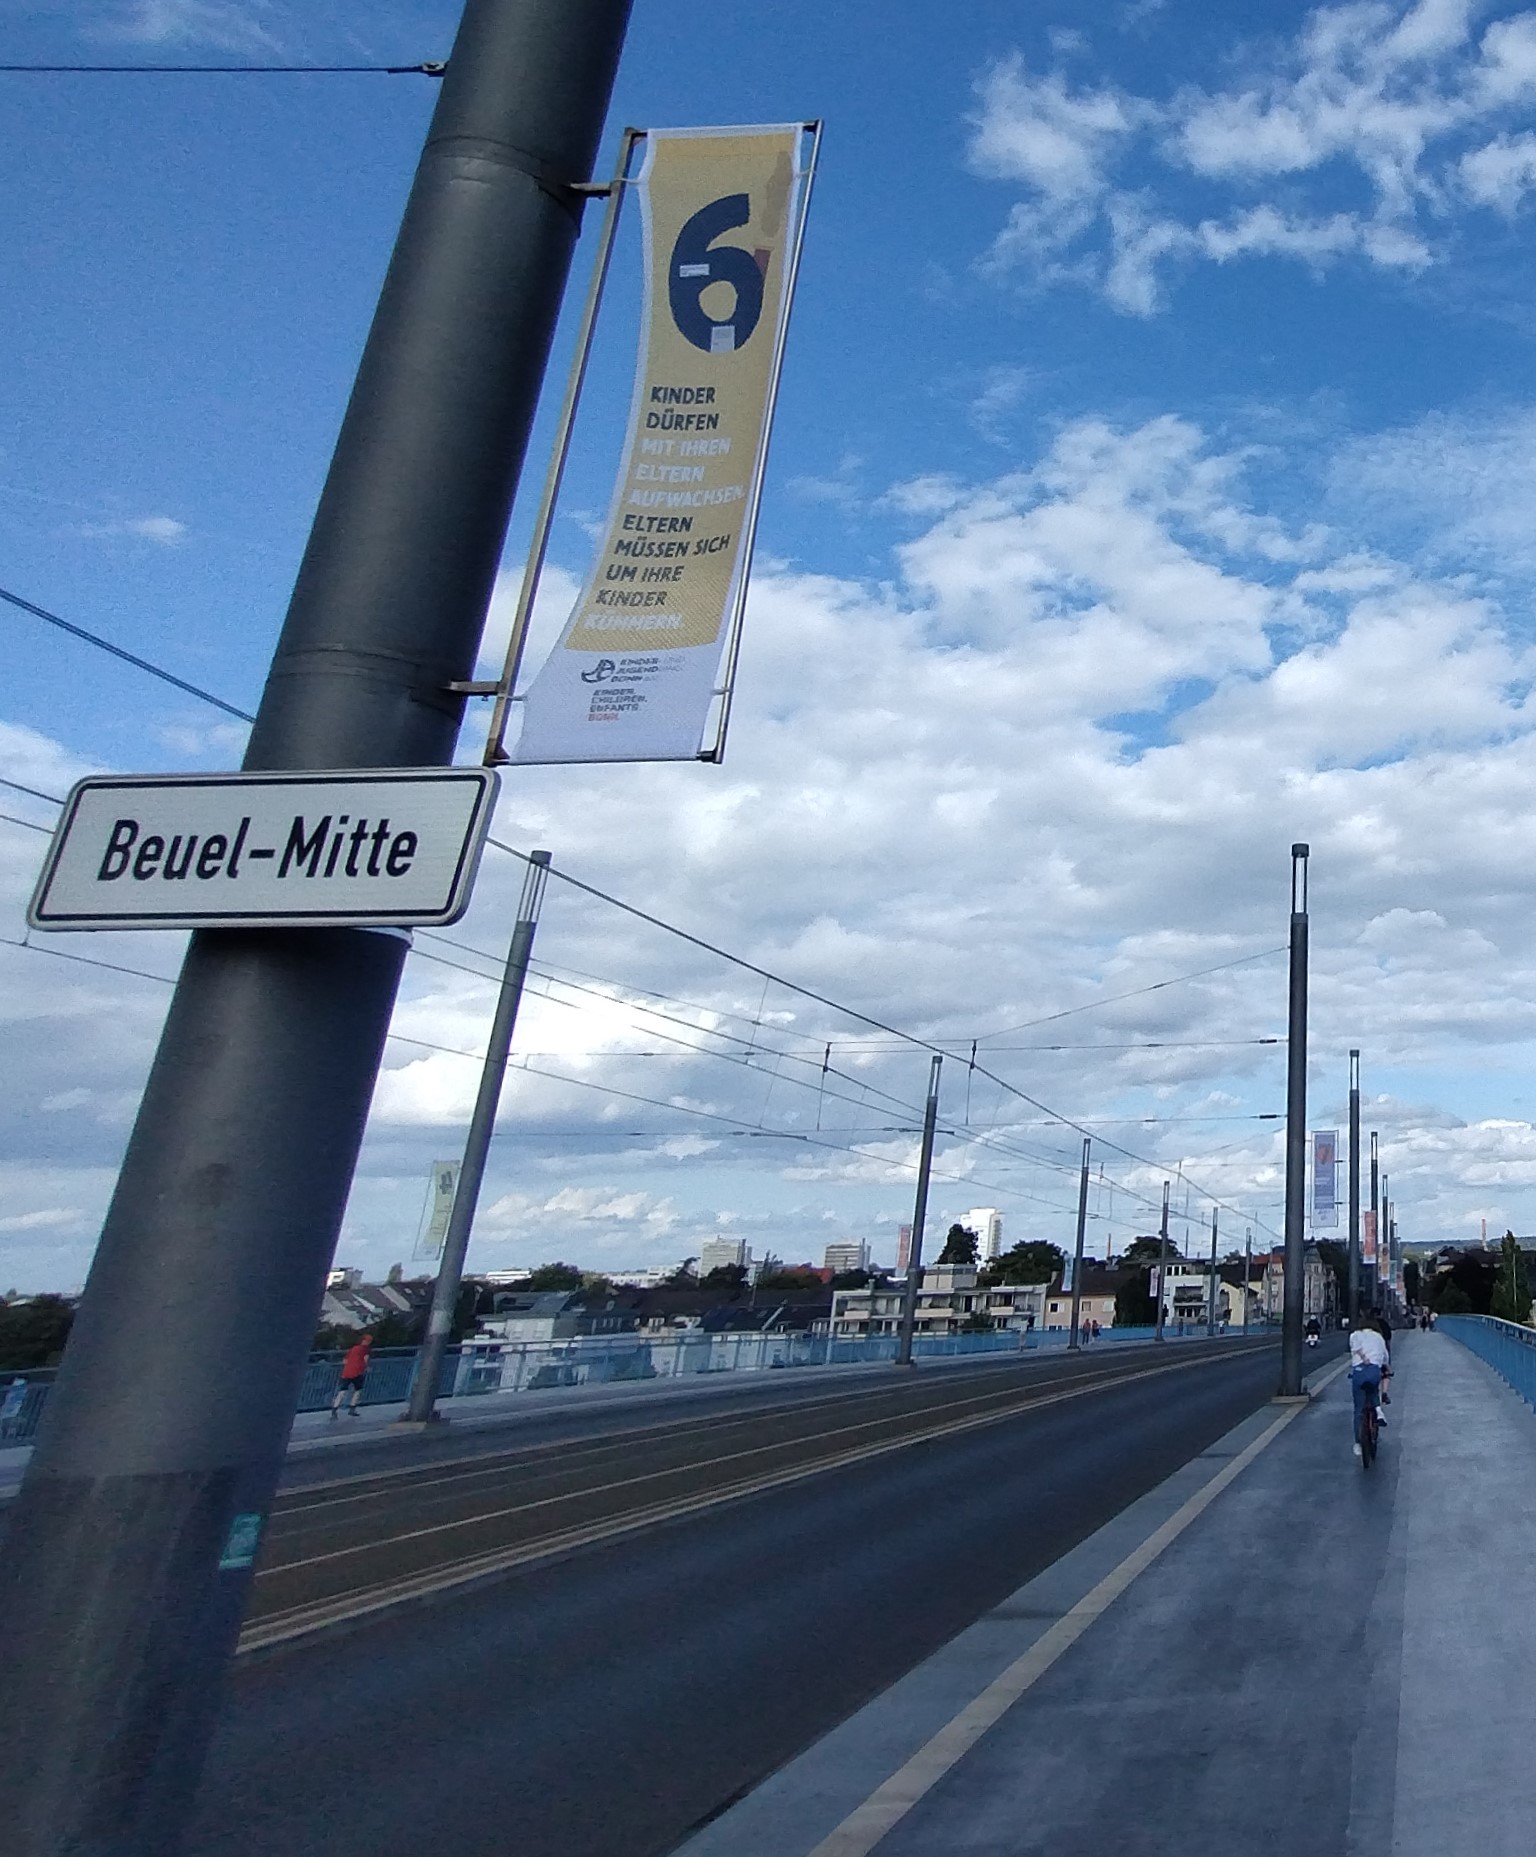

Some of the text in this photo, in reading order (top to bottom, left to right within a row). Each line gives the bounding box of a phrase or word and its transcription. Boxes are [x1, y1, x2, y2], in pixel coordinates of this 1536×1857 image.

[669, 193, 764, 353] 6
[651, 386, 716, 404] KINDER
[646, 408, 719, 430] DÜRFEN
[640, 438, 731, 456] MIT IHREN
[635, 463, 705, 482] ELTERN
[623, 514, 694, 533] ELTERN
[614, 534, 731, 558] MÜSSEN SICH
[606, 564, 685, 582] UM IHRE
[595, 589, 668, 607] KINDER
[98, 814, 419, 882] Beuel-Mitte
